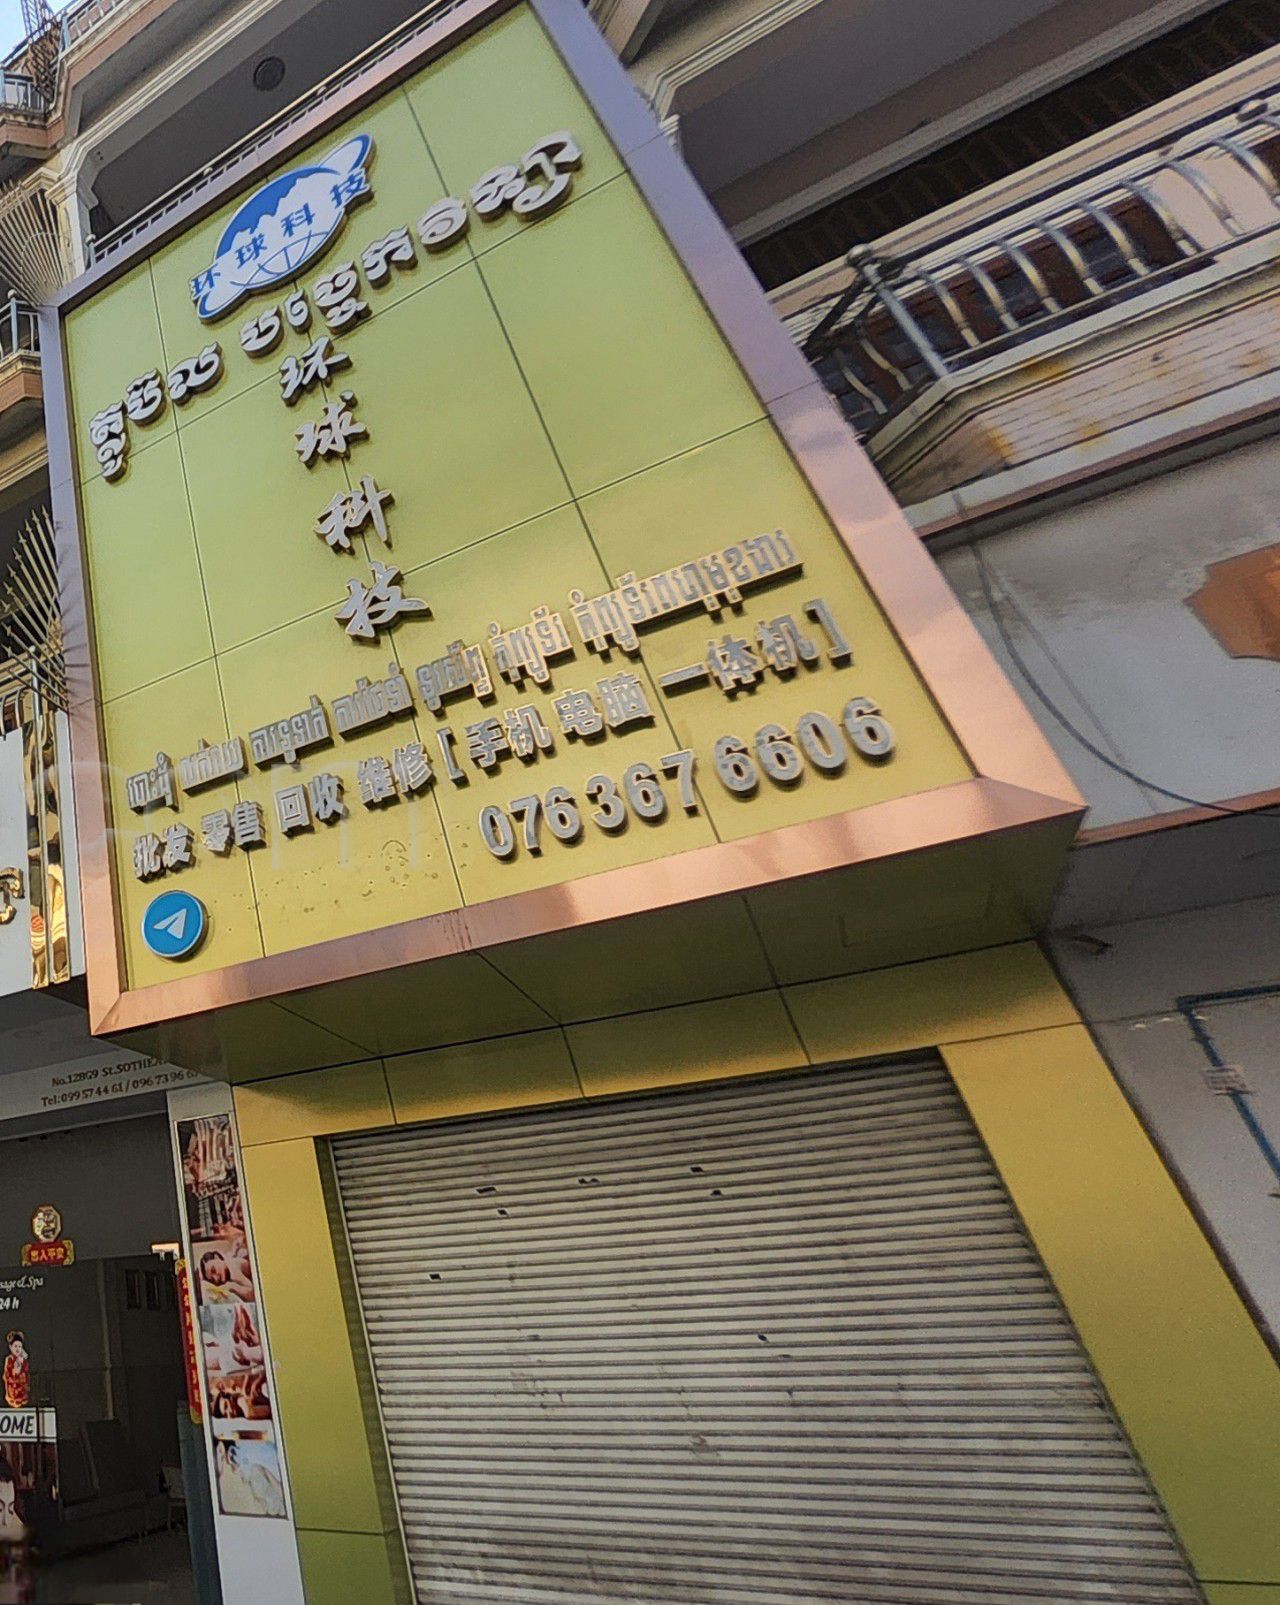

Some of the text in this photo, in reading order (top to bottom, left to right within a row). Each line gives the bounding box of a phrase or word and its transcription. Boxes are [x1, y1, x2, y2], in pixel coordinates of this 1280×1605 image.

[190, 169, 371, 301] 环球科技
[279, 336, 432, 643] 环球科技
[133, 822, 195, 883] 批发
[200, 800, 268, 857] 零售
[274, 772, 347, 838] 回收
[356, 740, 436, 810] 维修
[477, 695, 895, 859] 076 367 6606
[26, 1276, 44, 1290] Spa
